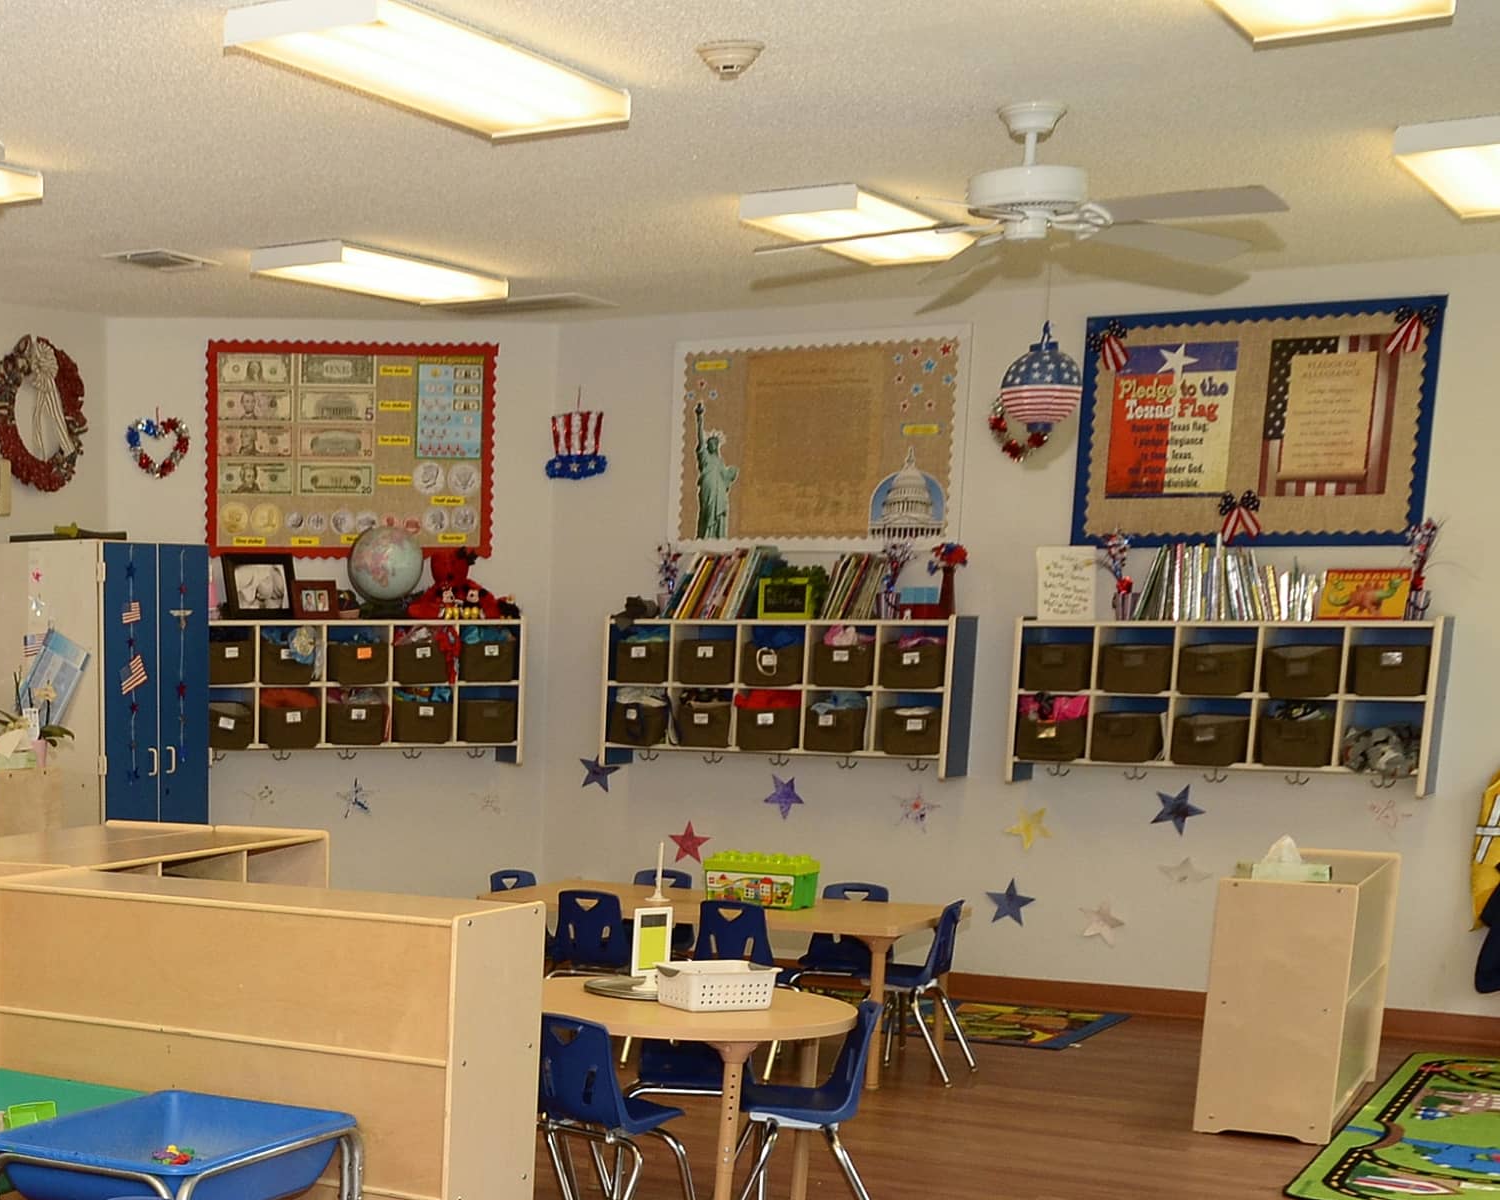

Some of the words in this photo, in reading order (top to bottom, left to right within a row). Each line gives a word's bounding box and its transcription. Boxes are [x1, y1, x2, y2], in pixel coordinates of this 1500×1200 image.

[1118, 378, 1176, 404] Pledge
[1180, 379, 1196, 397] to
[1200, 376, 1229, 397] the
[1124, 399, 1175, 421] Texas
[1178, 398, 1219, 422] Flag
[1170, 422, 1190, 432] Texas
